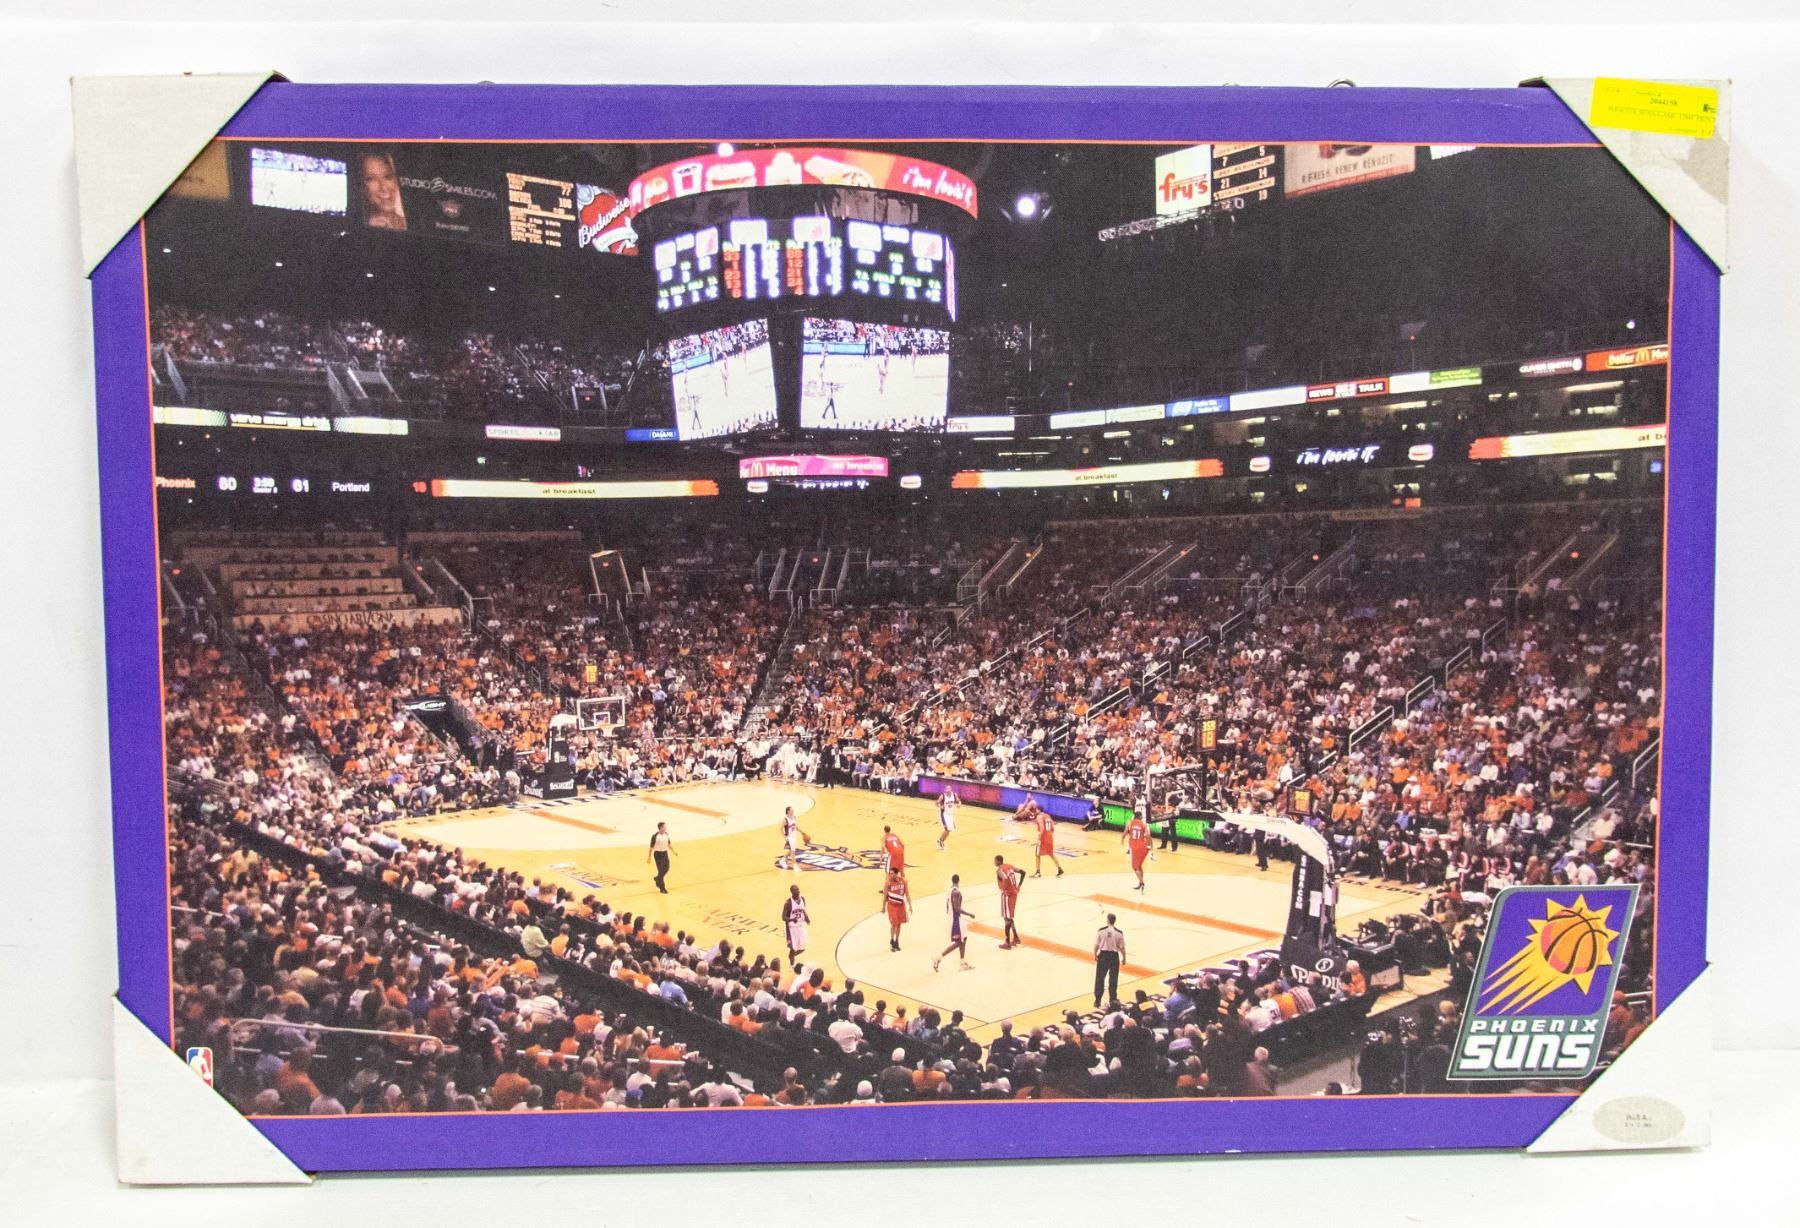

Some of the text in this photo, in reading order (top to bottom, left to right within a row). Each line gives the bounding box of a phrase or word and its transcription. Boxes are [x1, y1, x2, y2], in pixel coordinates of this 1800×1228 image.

[1258, 167, 1268, 179] 14
[1220, 178, 1230, 190] 21
[578, 197, 632, 249] Budweise
[1357, 382, 1384, 394] TALK
[766, 462, 799, 476] Menu
[155, 476, 197, 489] Phoenix
[332, 482, 371, 493] Portland
[554, 486, 597, 496] breakfast
[1131, 829, 1141, 840] 21
[1470, 1019, 1599, 1033] PHOENIX
[1459, 1034, 1595, 1070] SUNS
